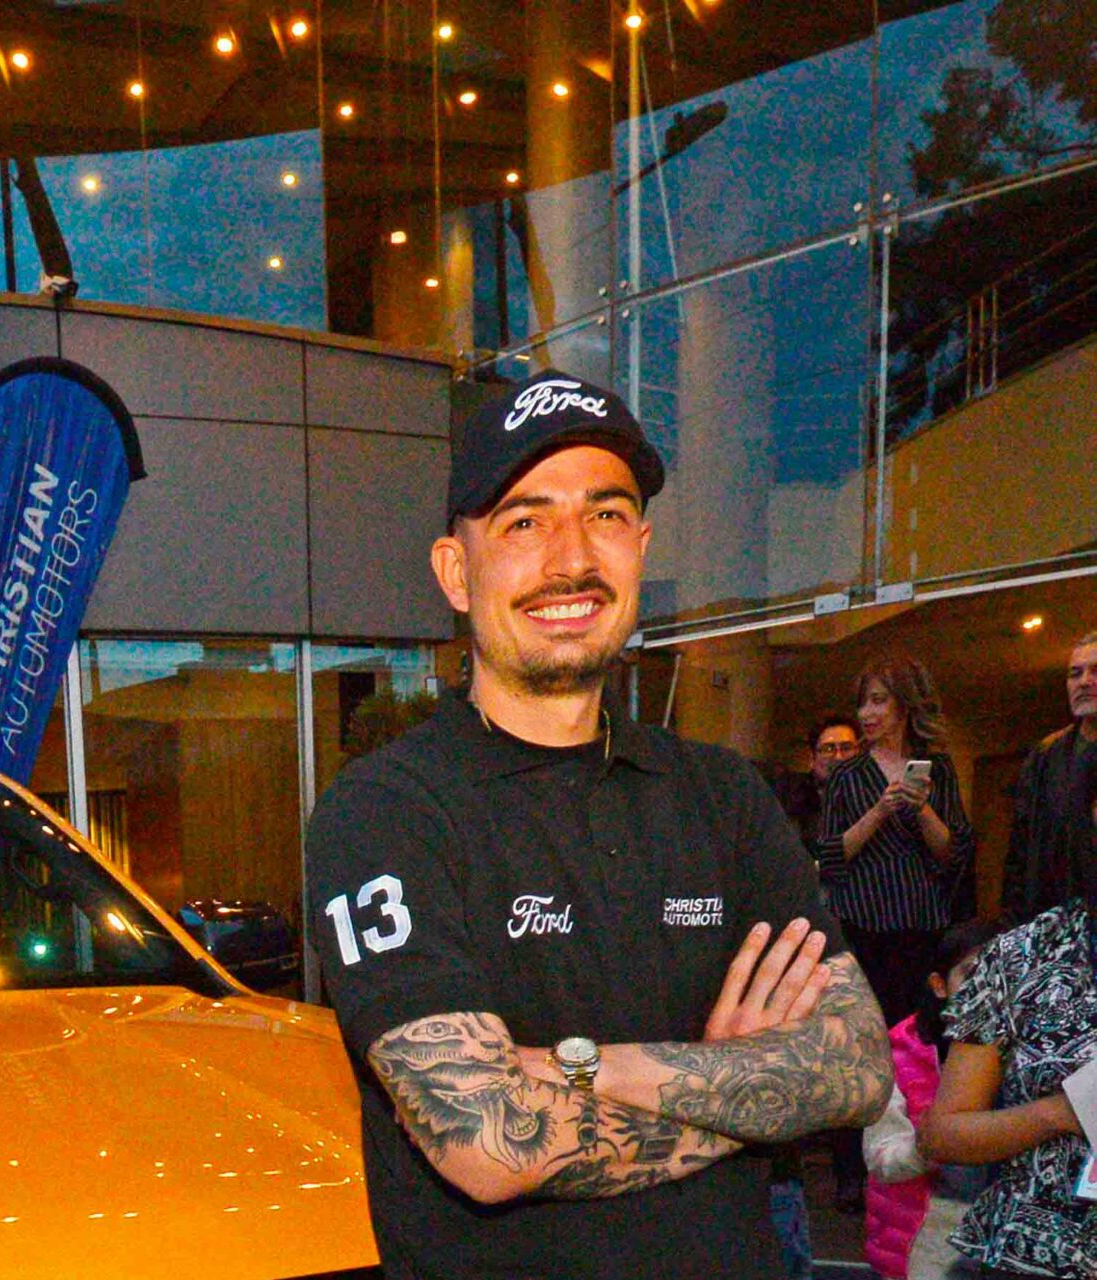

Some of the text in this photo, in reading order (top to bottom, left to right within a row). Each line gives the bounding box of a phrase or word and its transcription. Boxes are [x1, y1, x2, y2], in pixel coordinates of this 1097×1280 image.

[504, 379, 607, 431] Ford
[0, 480, 98, 754] AUTOMOTORS
[325, 874, 412, 966] 13
[507, 894, 574, 939] Ford
